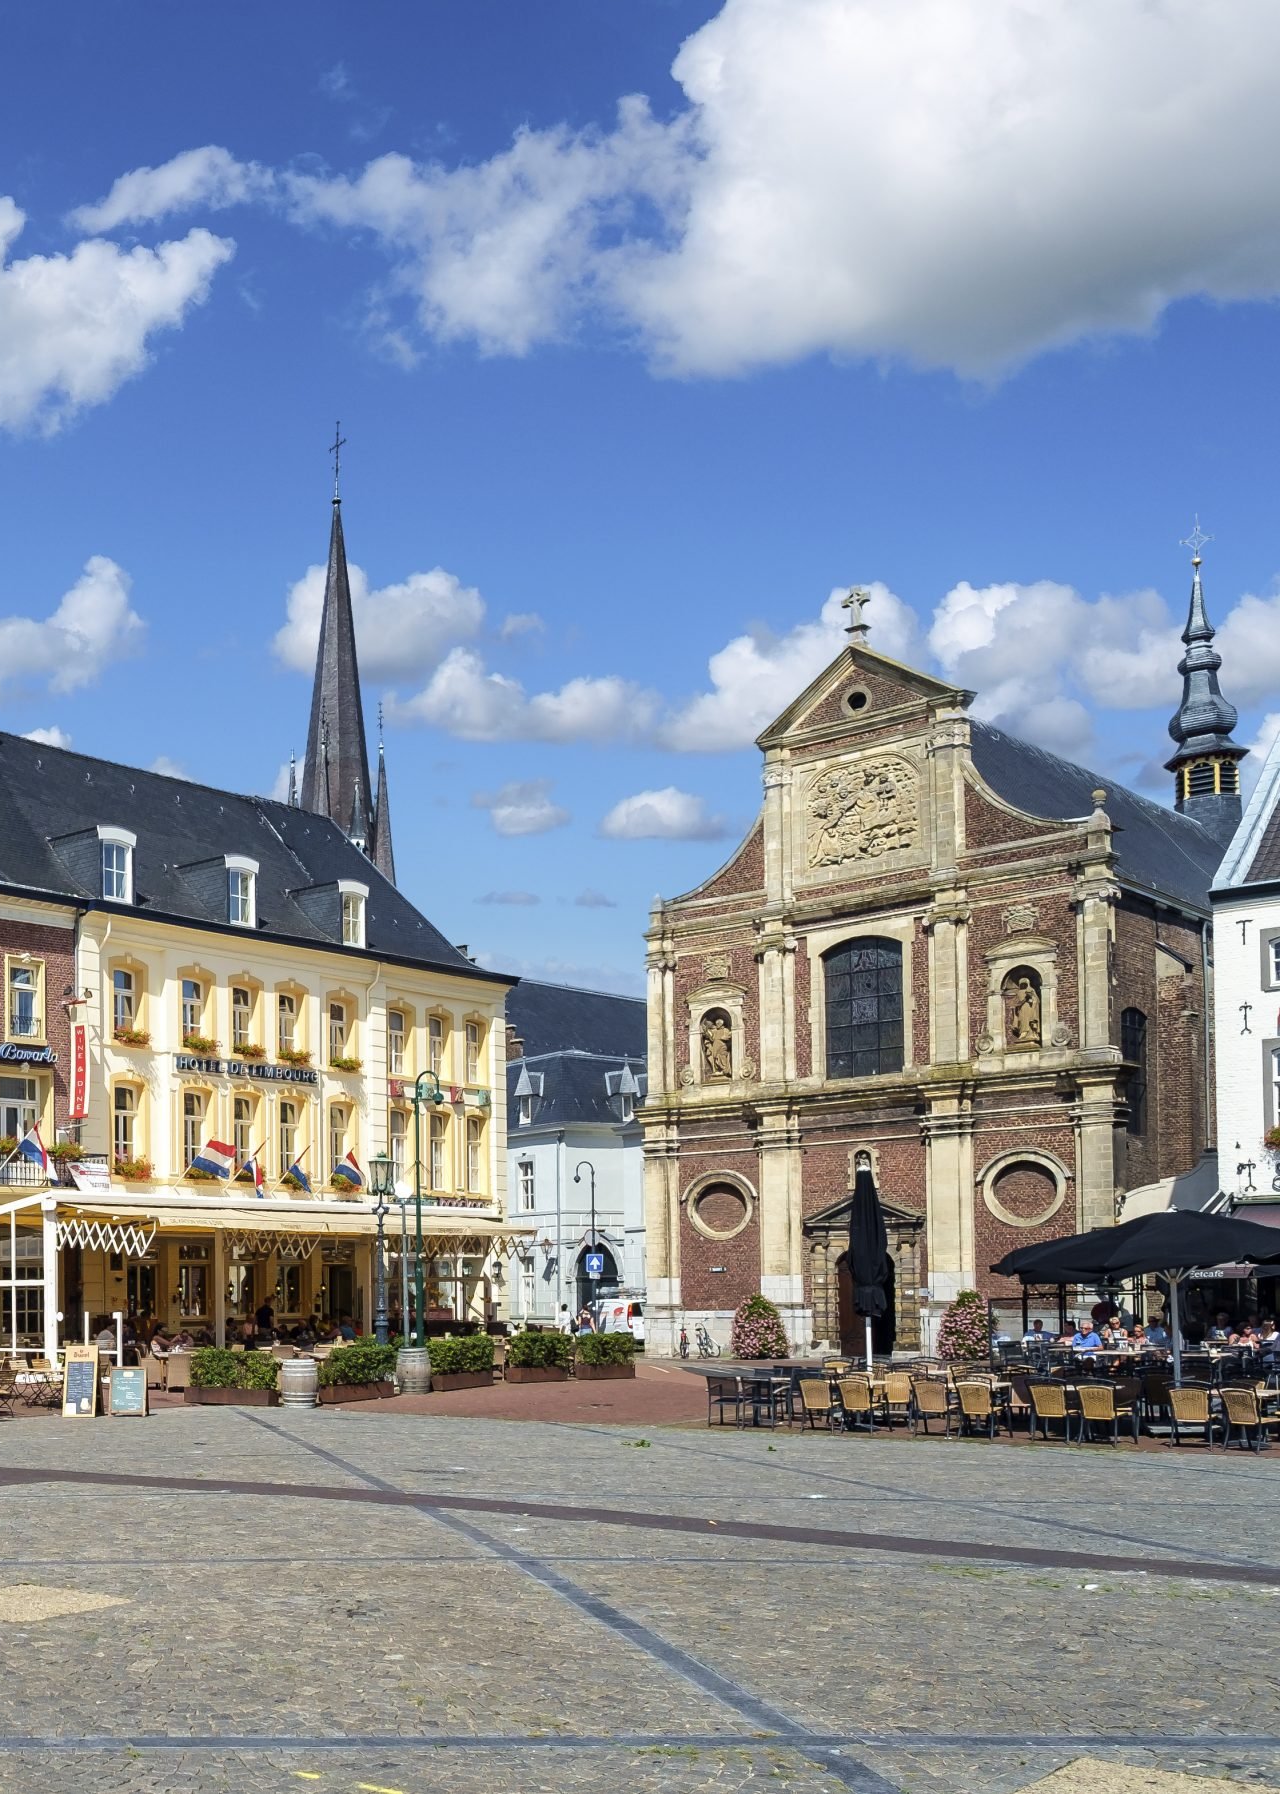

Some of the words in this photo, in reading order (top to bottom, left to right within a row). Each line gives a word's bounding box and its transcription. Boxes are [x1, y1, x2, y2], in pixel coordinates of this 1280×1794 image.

[0, 1042, 59, 1063] Bavaria
[179, 1056, 226, 1073] HOTEL
[230, 1062, 248, 1076] DE
[251, 1064, 319, 1083] LIMBOURG
[76, 1080, 84, 1110] DINE
